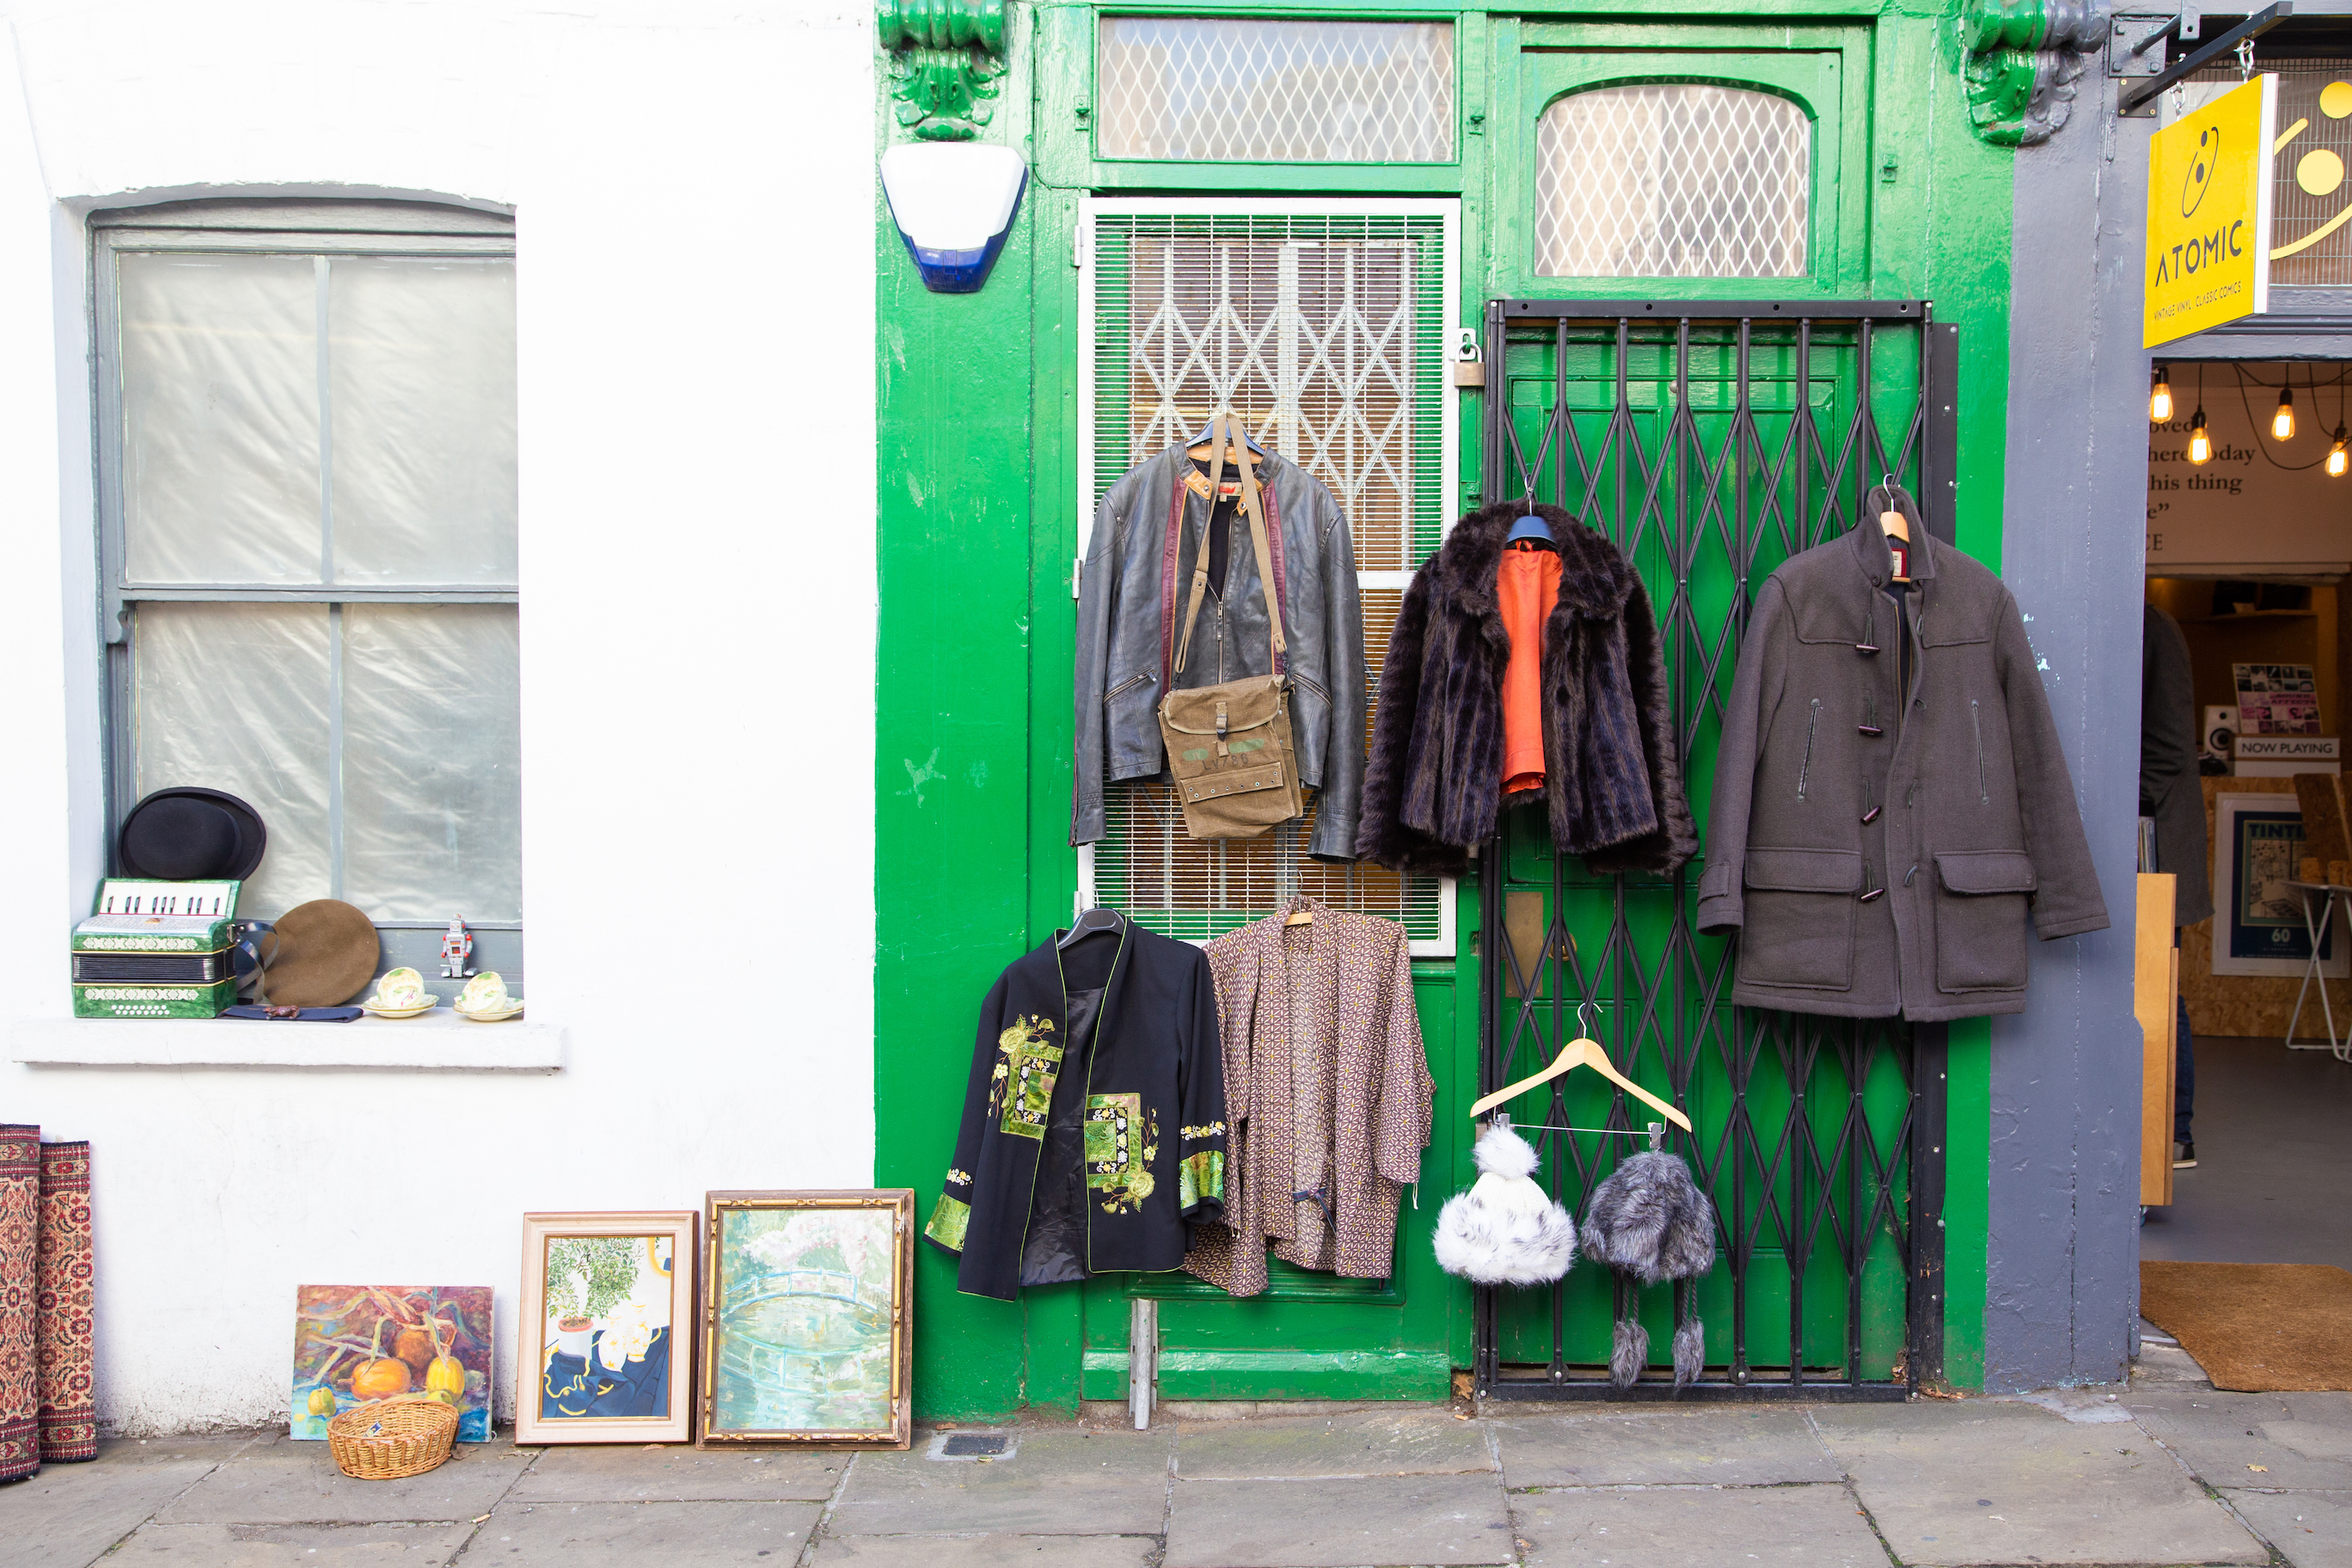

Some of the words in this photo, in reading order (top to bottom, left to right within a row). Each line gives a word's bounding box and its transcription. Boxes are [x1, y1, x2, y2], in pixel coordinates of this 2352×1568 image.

[2155, 219, 2243, 287] ATOMIC
[2154, 304, 2175, 322] VINTAGE
[2196, 289, 2218, 307] CLASSIC
[2220, 280, 2241, 298] COMICS
[2188, 473, 2243, 495] thing
[2242, 743, 2276, 753] NOW
[2281, 743, 2333, 753] PLAYING
[2249, 824, 2306, 838] TINTI
[2272, 928, 2291, 943] 60
